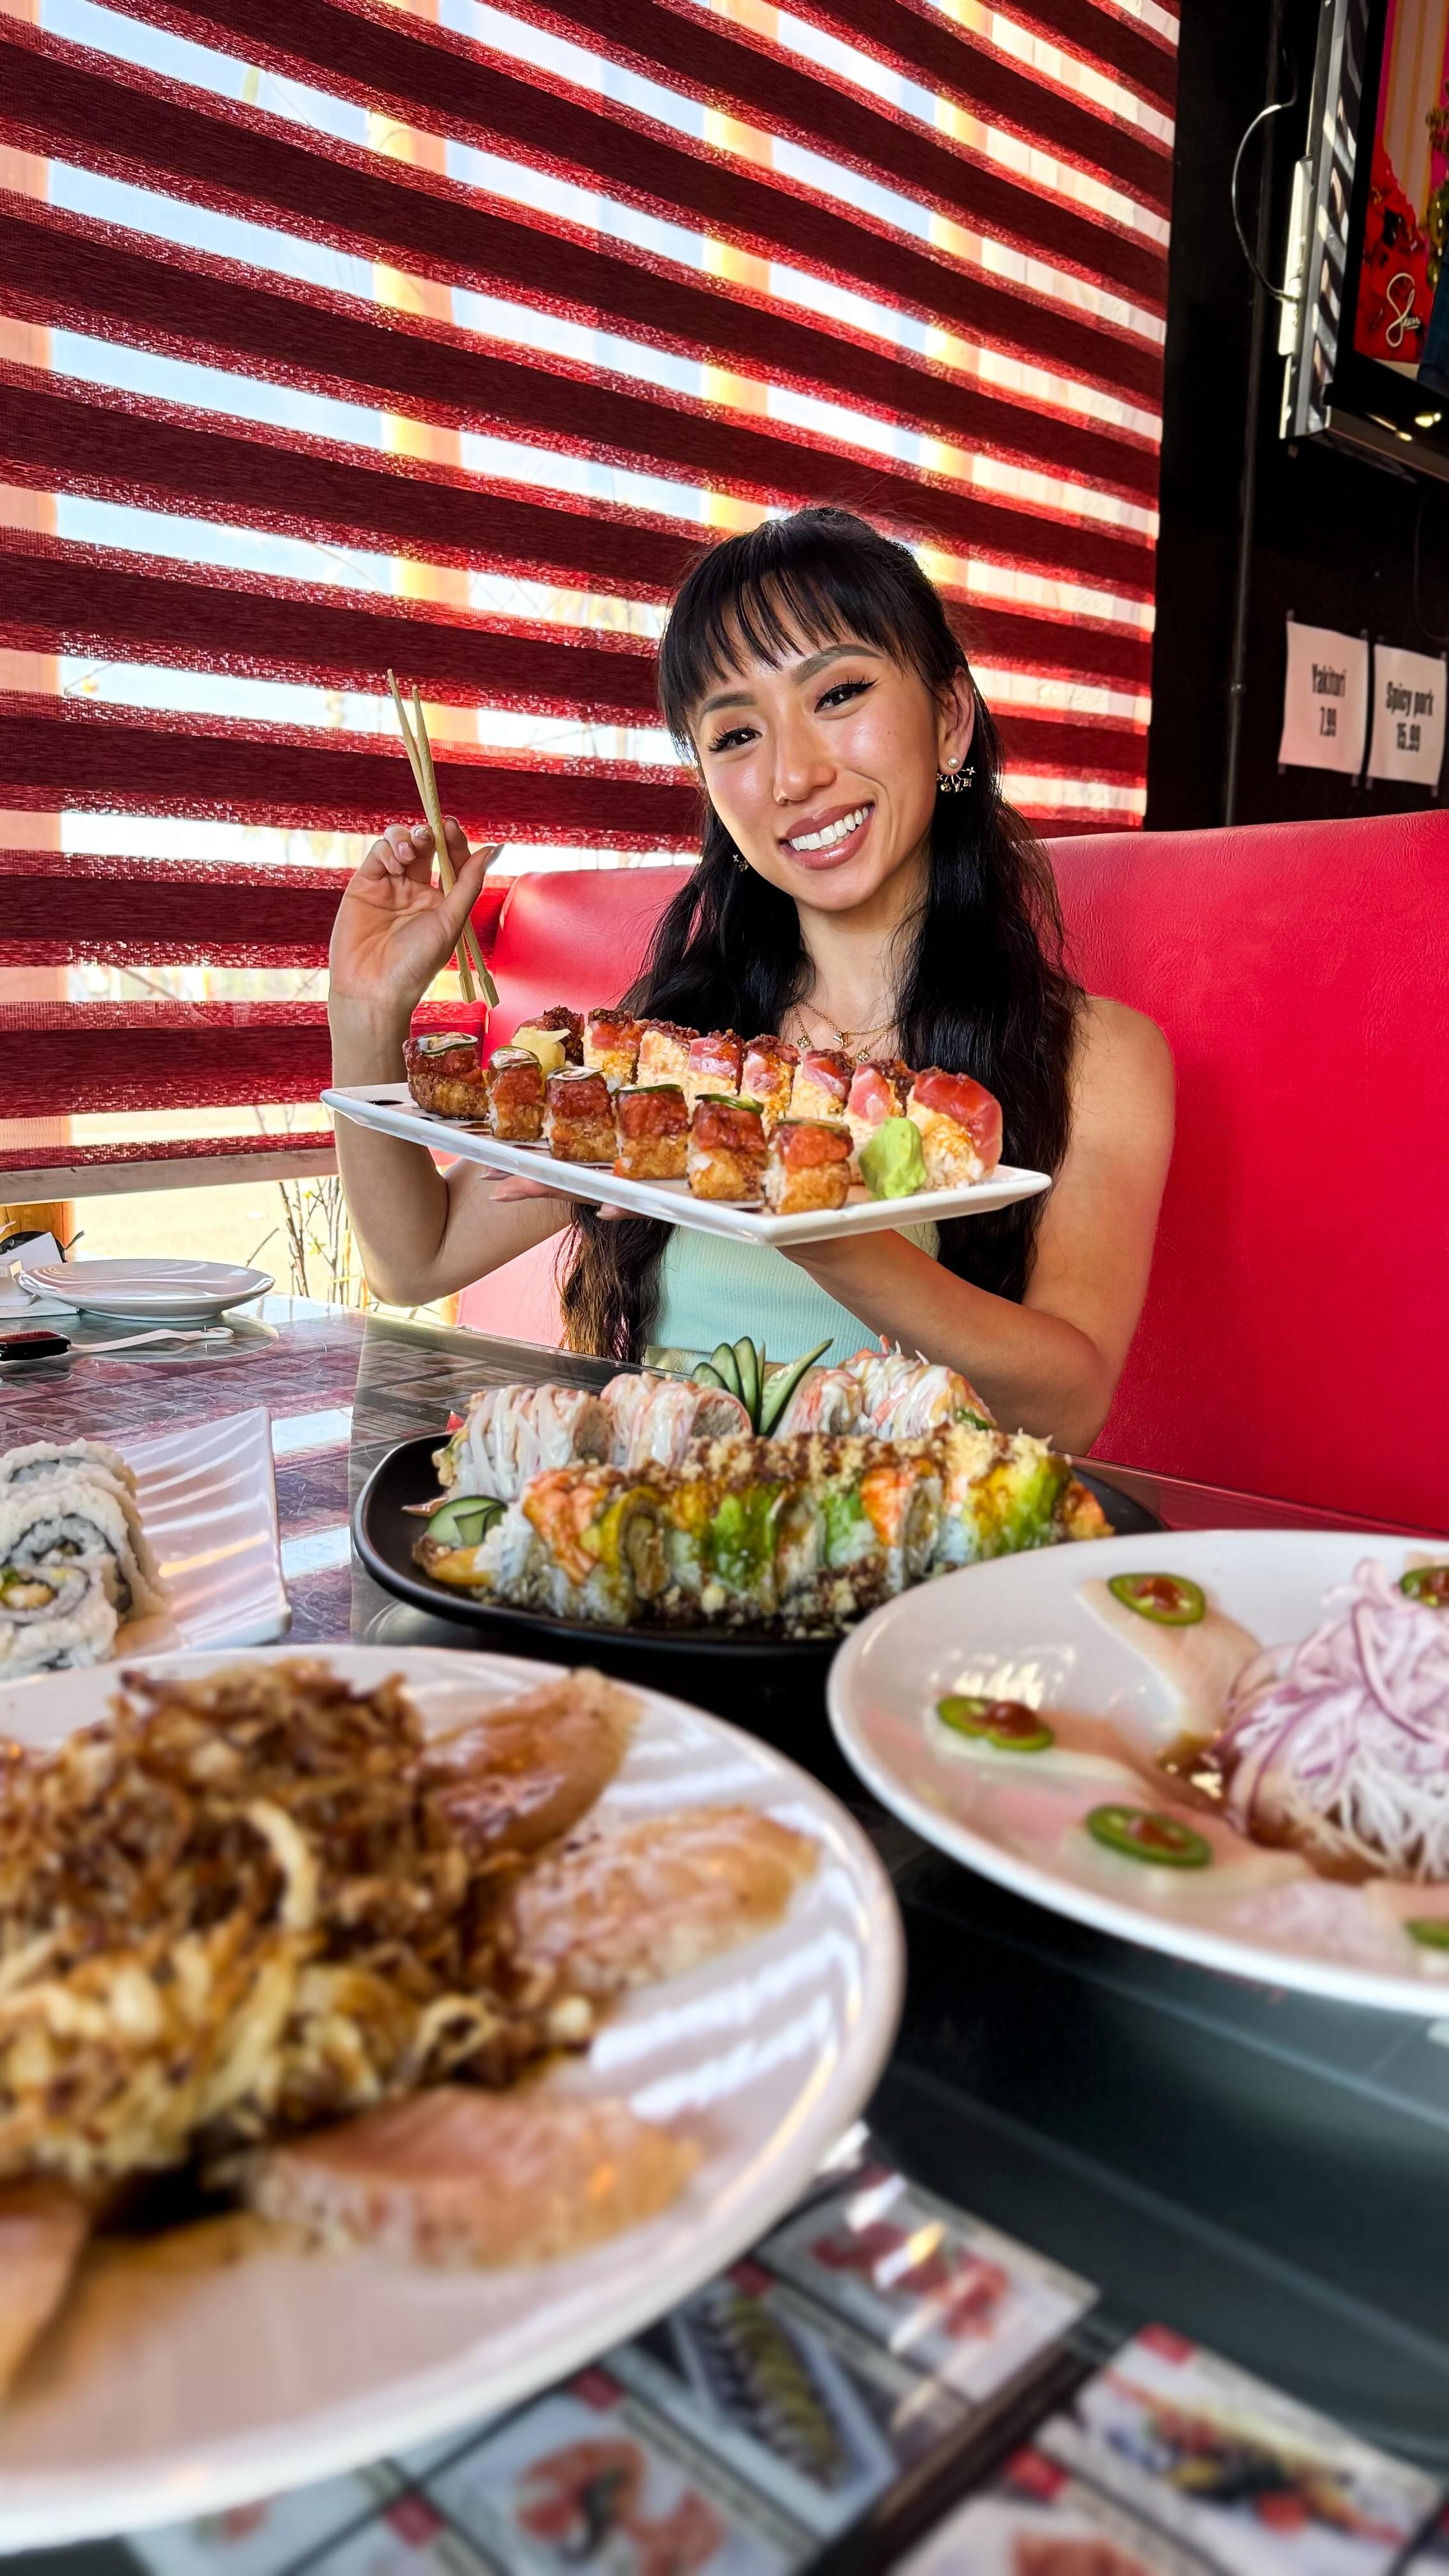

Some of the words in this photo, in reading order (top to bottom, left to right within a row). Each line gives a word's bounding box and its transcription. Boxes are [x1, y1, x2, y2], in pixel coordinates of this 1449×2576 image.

[1312, 663, 1346, 698] Yakitori
[1386, 681, 1413, 717] Spicy
[1413, 689, 1434, 717] pork
[1320, 706, 1337, 737] 7.99
